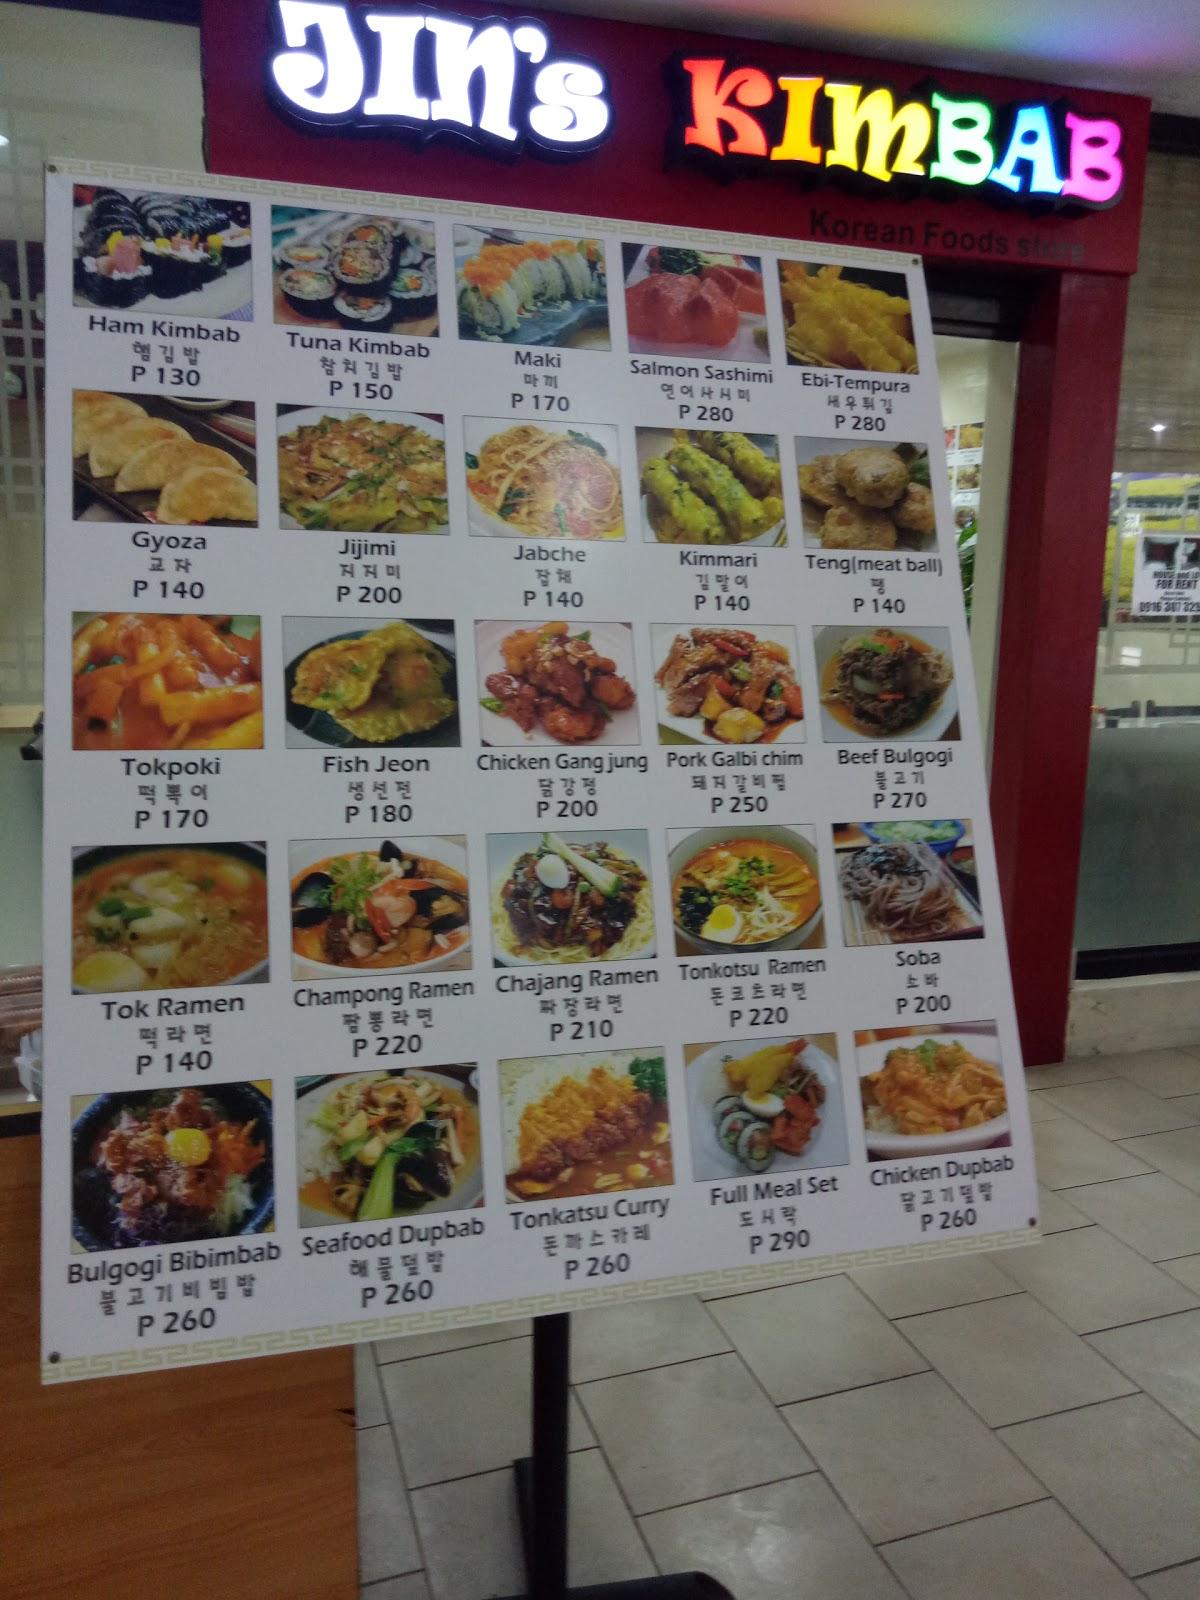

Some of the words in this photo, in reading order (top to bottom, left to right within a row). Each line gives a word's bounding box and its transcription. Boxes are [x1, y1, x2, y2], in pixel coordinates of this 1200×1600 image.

[683, 58, 1123, 202] KIMBAB
[810, 208, 914, 247] Korean
[923, 221, 1008, 254] Foods
[88, 314, 145, 335] Ham
[151, 317, 241, 343] Kimbab
[285, 331, 342, 352] Tuna
[348, 332, 432, 359] Kimbab
[514, 350, 562, 369] Maki
[131, 365, 147, 383] P
[157, 367, 201, 387] 130
[630, 359, 700, 379] Salmon
[704, 364, 774, 384] Sashimi
[801, 371, 910, 394] Ebi-Tempura
[329, 380, 344, 397] P
[352, 381, 393, 401] 150
[511, 392, 524, 409] P
[532, 394, 570, 412] 170
[679, 404, 691, 420] P
[696, 405, 734, 423] 280
[834, 414, 847, 429] P
[851, 415, 886, 432] 280
[131, 530, 207, 554] Gyoza
[338, 538, 396, 561] Jijimi
[513, 544, 587, 563] Jabche
[679, 550, 758, 568] Kimmari
[148, 556, 193, 574] 교자
[133, 579, 149, 598] P
[159, 580, 205, 600] 140
[337, 585, 351, 603] P
[357, 585, 403, 604] 200
[1156, 579, 1173, 589] FOR
[1175, 579, 1198, 589] RENT
[523, 590, 537, 607] P
[545, 590, 584, 608] 140
[694, 594, 707, 611] P
[714, 595, 751, 612] 140
[853, 597, 865, 613] P
[871, 598, 906, 614] 140
[323, 755, 369, 773] Fish
[374, 755, 430, 773] Jeon
[476, 753, 551, 771] Chicken
[666, 751, 708, 768] Pork
[711, 750, 758, 767] Galbi
[762, 750, 803, 768] chim
[837, 748, 879, 765] Beef
[883, 747, 953, 768] Bulgogi
[119, 757, 221, 781] Tokpoki
[536, 800, 551, 819] P
[556, 799, 599, 818] 200
[711, 796, 724, 814] P
[729, 795, 769, 814] 250
[873, 792, 886, 809] P
[890, 791, 928, 809] 270
[134, 810, 151, 830] P
[162, 808, 209, 829] 170
[345, 805, 360, 824] P
[369, 804, 413, 823] 180
[895, 949, 941, 967] Soba
[677, 962, 760, 981] Tonkotsu
[767, 958, 827, 975] Ramen
[495, 972, 584, 996] Chajang
[589, 969, 659, 987] Ramen
[293, 986, 404, 1009] Champong
[408, 981, 475, 1000] Ramen
[896, 997, 909, 1015] P
[913, 994, 952, 1014] 200
[100, 999, 150, 1021] Tok
[156, 996, 245, 1017] Ramen
[729, 1009, 743, 1028] P
[748, 1006, 789, 1027] 220
[550, 1022, 564, 1042] P
[570, 1019, 614, 1041] 210
[353, 1038, 369, 1058] P
[375, 1033, 423, 1056] 220
[136, 1054, 153, 1076] P
[164, 1050, 213, 1073] 140
[869, 1165, 942, 1187] Chicken
[945, 1154, 1015, 1180] Dupbab
[710, 1185, 748, 1206] Full
[753, 1179, 803, 1201] Meal
[807, 1176, 839, 1195] Set
[508, 1205, 609, 1231] Tonkatsu
[613, 1198, 671, 1219] Curry
[920, 1213, 934, 1232] P
[938, 1207, 977, 1230] 260
[301, 1227, 393, 1257] Seafood
[399, 1217, 485, 1247] Dupbab
[749, 1235, 764, 1255] P
[769, 1229, 811, 1252] 290
[67, 1253, 163, 1286] Bulgogi
[169, 1241, 281, 1273] Bibimbab
[564, 1259, 580, 1280] P
[586, 1252, 631, 1277] 260
[361, 1286, 377, 1309] P
[384, 1279, 434, 1306] 260
[137, 1314, 155, 1338] P
[162, 1307, 216, 1334] 260
